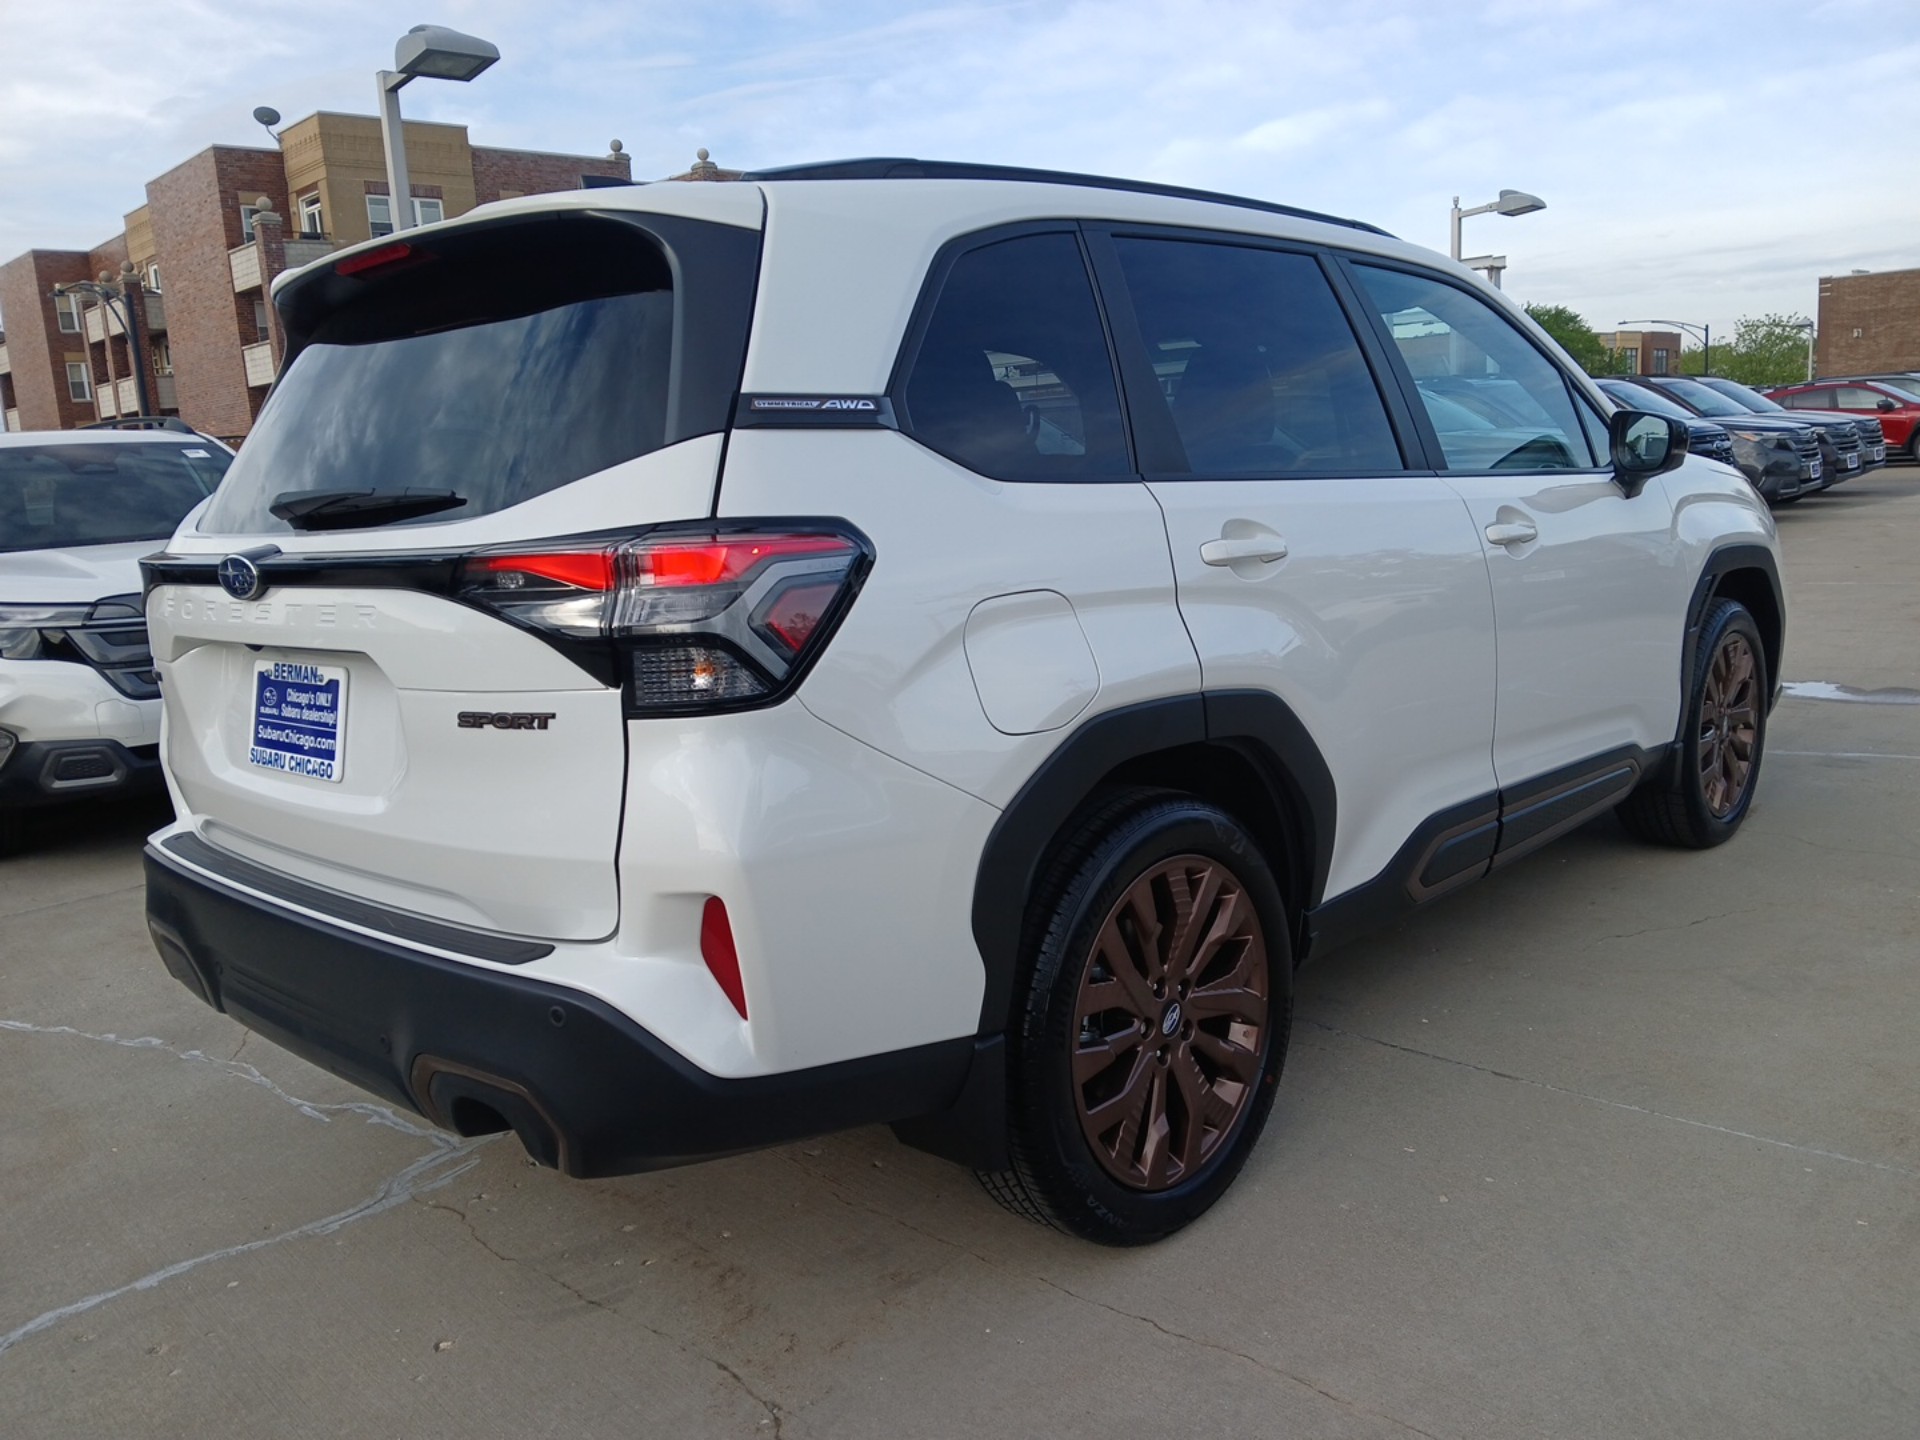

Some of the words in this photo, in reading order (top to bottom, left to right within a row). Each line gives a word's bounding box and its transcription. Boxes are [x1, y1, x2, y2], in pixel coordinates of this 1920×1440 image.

[821, 399, 876, 409] AWD
[164, 598, 377, 629] FORESTER
[273, 662, 318, 684] BERMAN
[286, 688, 315, 706] Chicago's
[315, 691, 333, 707] ONLY
[280, 703, 301, 719] Subaru
[301, 706, 337, 727] dealership!
[457, 711, 557, 730] SPORT
[258, 724, 336, 752] SubaruChicago.com
[249, 747, 286, 770] SUBARU
[288, 755, 334, 780] CHICAGO
